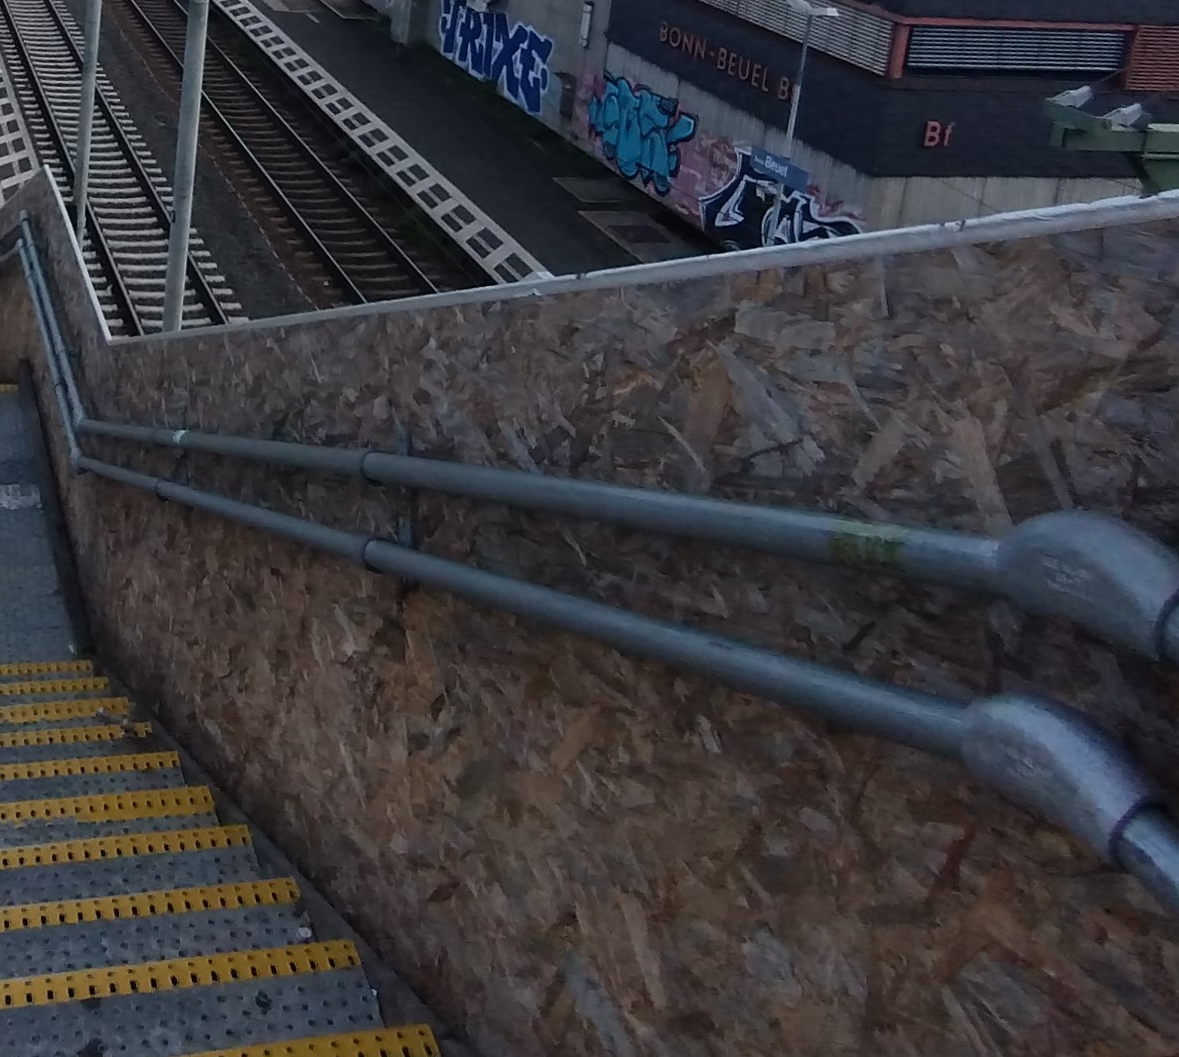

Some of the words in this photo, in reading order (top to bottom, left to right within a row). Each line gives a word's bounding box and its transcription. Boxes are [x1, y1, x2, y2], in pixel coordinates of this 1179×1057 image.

[659, 21, 770, 93] BONN-BEUEL
[923, 120, 957, 147] Bf
[764, 155, 789, 178] Beuel
